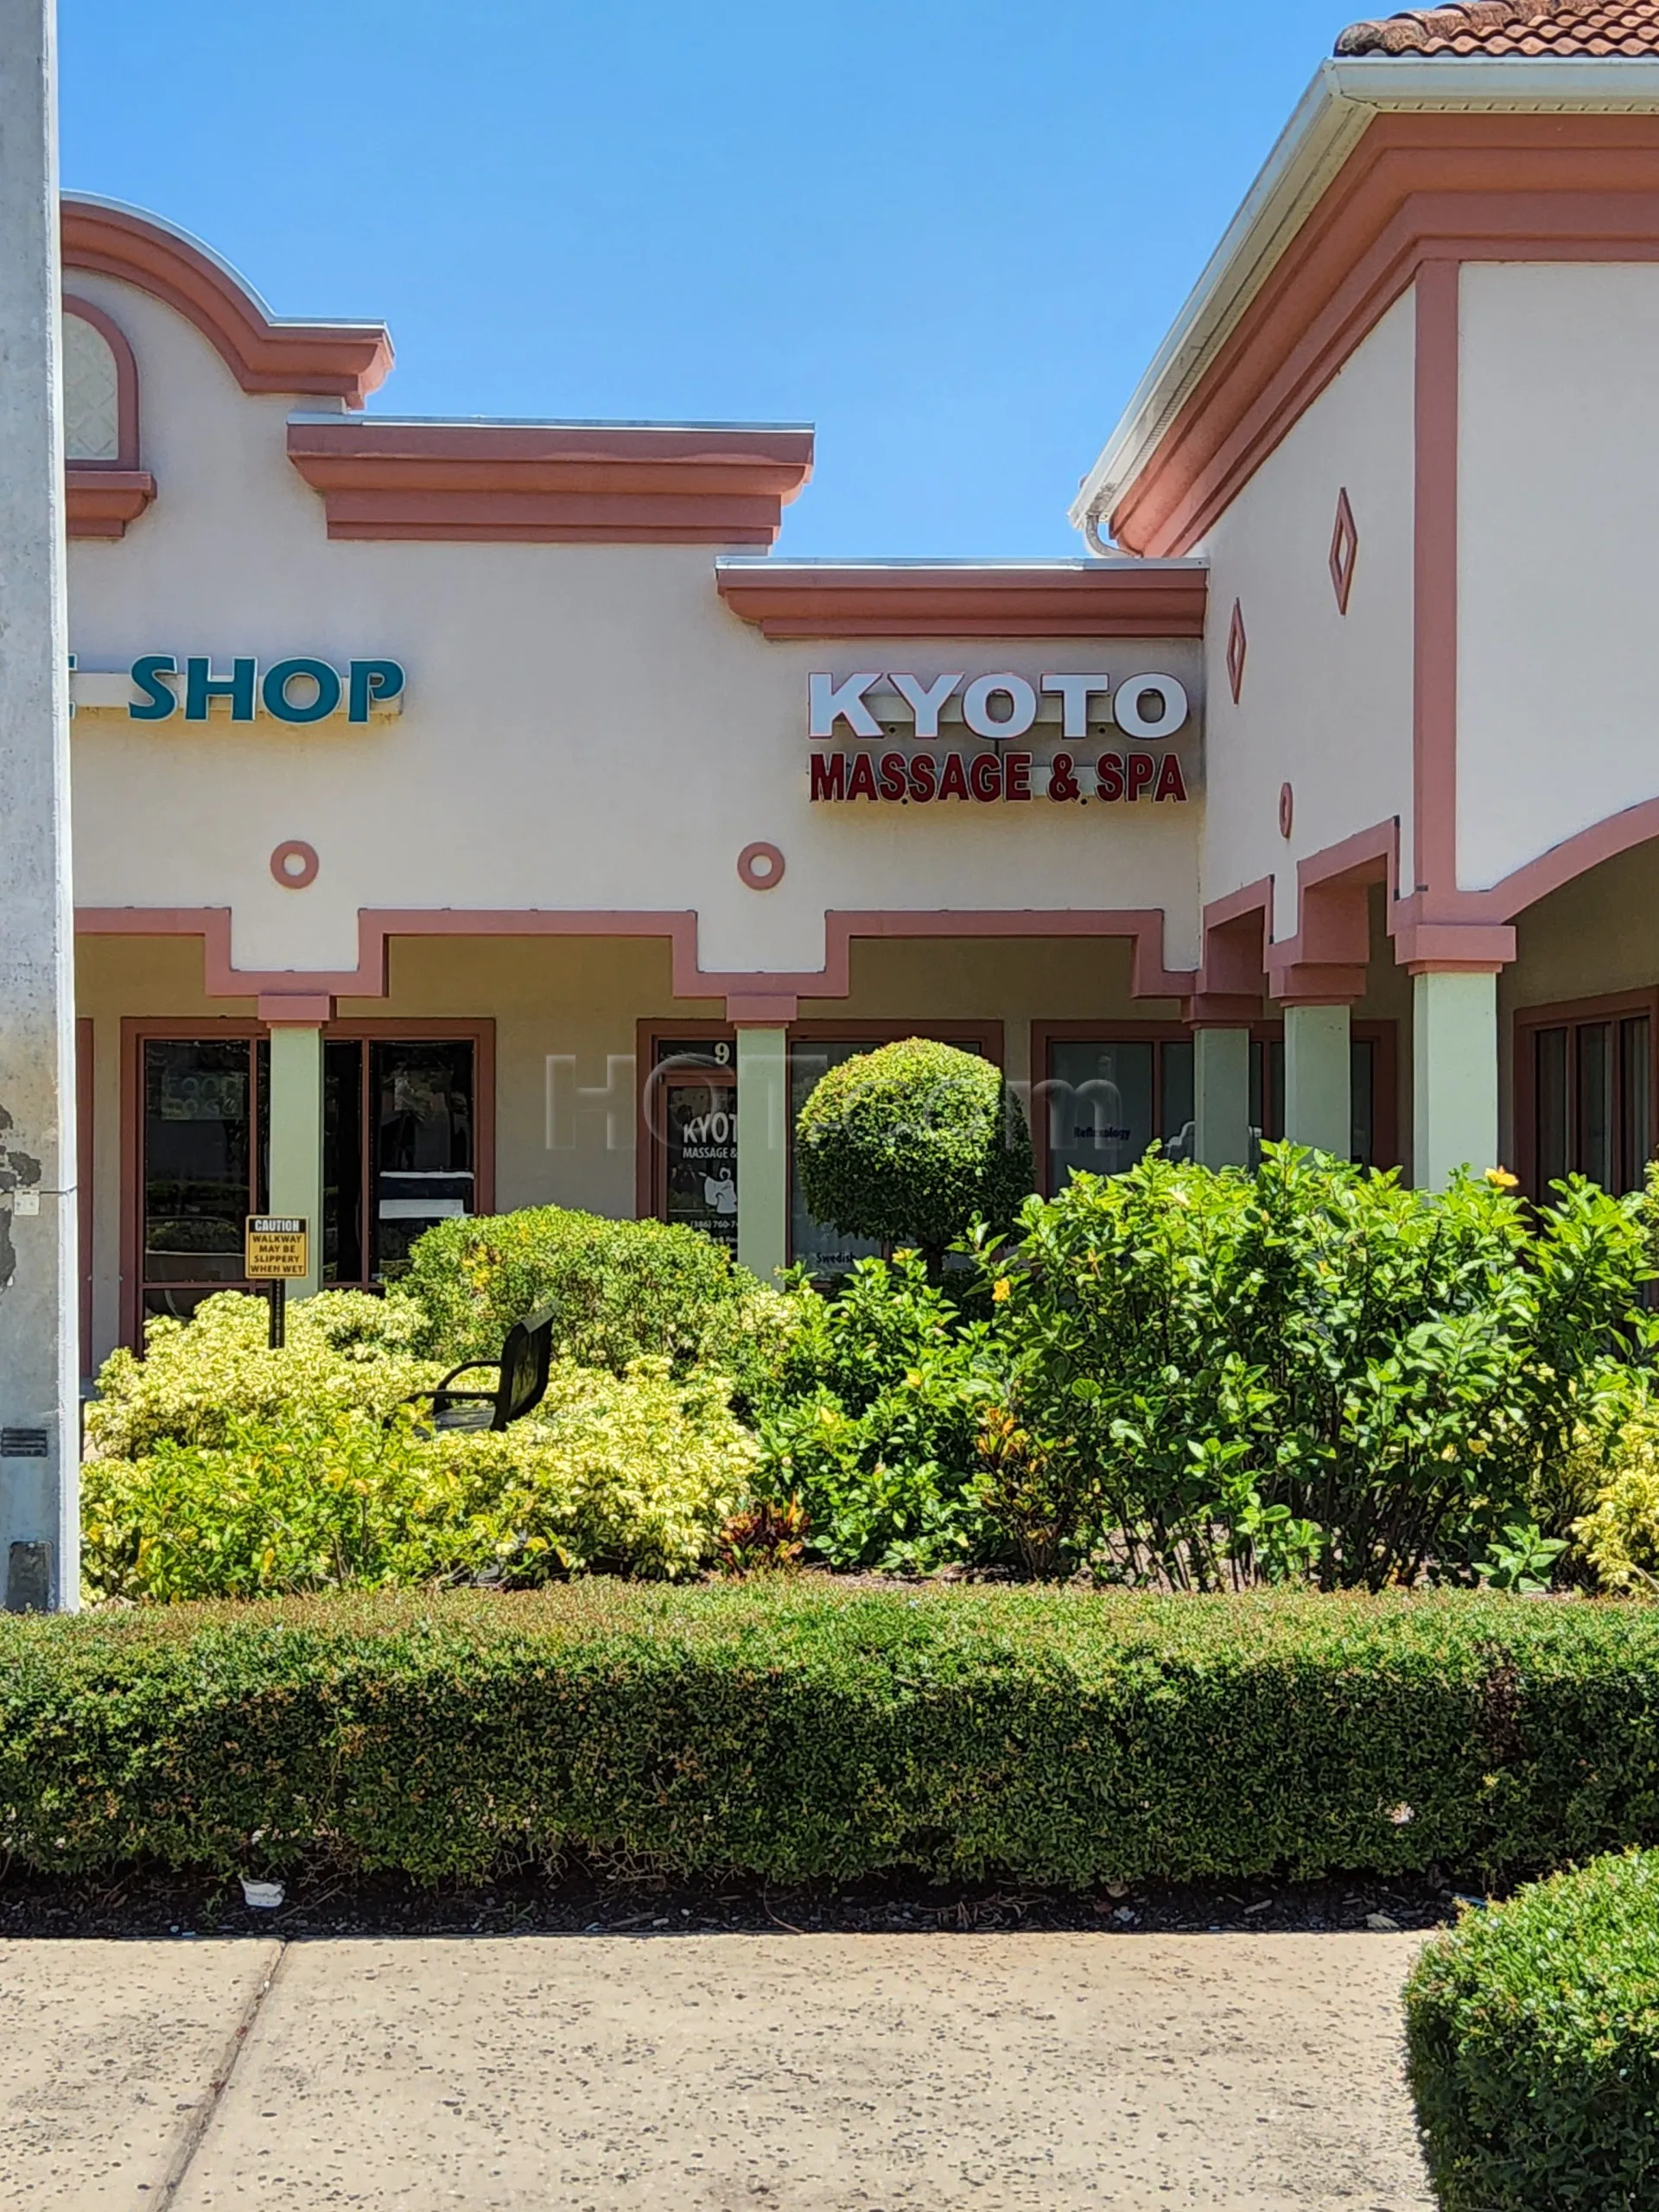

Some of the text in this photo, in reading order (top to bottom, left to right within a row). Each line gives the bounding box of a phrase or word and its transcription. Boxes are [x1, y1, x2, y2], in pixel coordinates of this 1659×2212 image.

[128, 653, 406, 724] SHOP
[808, 671, 1189, 740] KYOTO
[810, 752, 1188, 803] MASSAGE & SPA
[715, 1042, 730, 1065] 9
[683, 1111, 737, 1143] KYOT
[683, 1147, 728, 1159] MASSAGE
[254, 1219, 300, 1232] CAUTION
[252, 1234, 302, 1243] WALKWAY
[259, 1244, 296, 1253] MAY BE
[253, 1255, 300, 1263] SLIPPERY
[251, 1265, 304, 1274] WHEN WET
